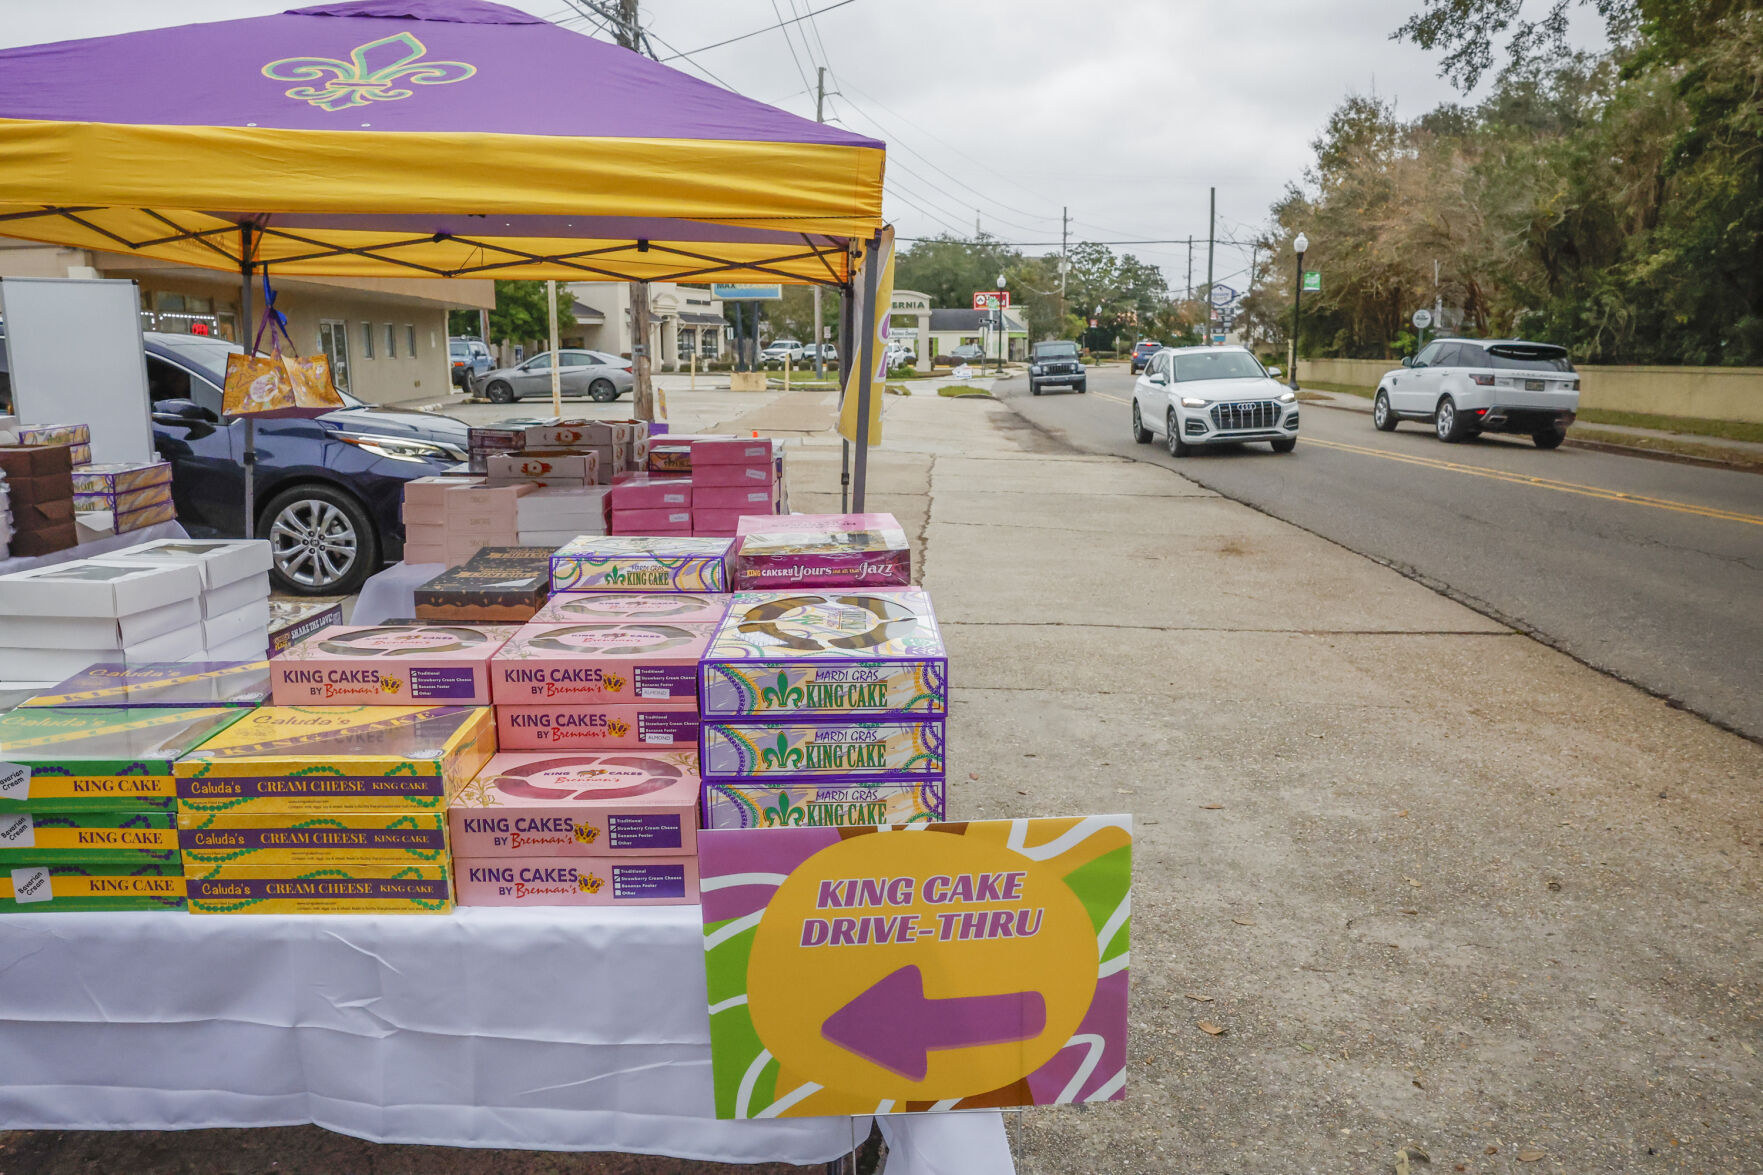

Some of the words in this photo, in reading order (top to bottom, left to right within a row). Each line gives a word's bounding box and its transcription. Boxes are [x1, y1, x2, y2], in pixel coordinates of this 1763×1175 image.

[856, 562, 894, 579] Jazz
[626, 573, 646, 585] KING
[648, 572, 669, 585] CAKE
[291, 623, 310, 640] SHARE
[310, 619, 319, 631] THE
[283, 670, 323, 683] KING
[327, 670, 379, 683] CAKES
[505, 669, 544, 682] KING
[550, 669, 603, 682] CAKES
[815, 669, 849, 681] MARDI
[852, 669, 879, 682] GRAS
[324, 683, 379, 698] Brennan's
[532, 686, 543, 694] BY
[546, 682, 601, 697] Brennan's
[806, 685, 844, 709] KING
[847, 684, 888, 708] CAKE
[252, 716, 350, 725] Caluda's
[511, 714, 550, 727] KING
[556, 714, 607, 727] CAKES
[222, 735, 322, 755] KING
[340, 711, 436, 735] CAKE
[552, 727, 606, 741] Brennan's
[815, 730, 848, 742] MARDI
[851, 730, 878, 742] GRAS
[806, 745, 844, 768] KING
[847, 744, 887, 767] CAKE
[0, 769, 24, 786] avarian
[2, 778, 24, 791] Cream
[74, 780, 114, 792] KING
[118, 780, 161, 792] CAKE
[191, 781, 242, 794] Caluda's
[257, 782, 307, 792] CREAM
[311, 781, 365, 792] CHEESE
[815, 790, 848, 802] MARDI
[851, 790, 878, 801] GRAS
[807, 803, 845, 827] KING
[847, 803, 887, 825] CAKE
[1, 817, 26, 839] Bavarian
[464, 818, 509, 832] KING
[515, 818, 573, 832] CAKES
[9, 824, 28, 841] Cream
[79, 832, 117, 844] KING
[122, 832, 163, 844] CAKE
[195, 833, 245, 845] Caluda's
[260, 833, 309, 844] CREAM
[313, 833, 367, 844] CHEESE
[494, 837, 508, 845] BY
[510, 833, 572, 848] Brennan's
[470, 869, 514, 882] KING
[520, 868, 578, 882] CAKES
[18, 871, 43, 894] Bavarian
[26, 878, 45, 896] Cream
[90, 880, 129, 891] KING
[133, 880, 174, 891] CAKE
[202, 883, 251, 895] Caluda's
[266, 884, 314, 894] CREAM
[319, 884, 372, 894] CHEESE
[499, 887, 512, 895] BY
[516, 883, 576, 899] Brennan's
[816, 876, 917, 909] KING
[921, 871, 1027, 903] CAKE
[800, 908, 1044, 948] DRIVE-THRU
